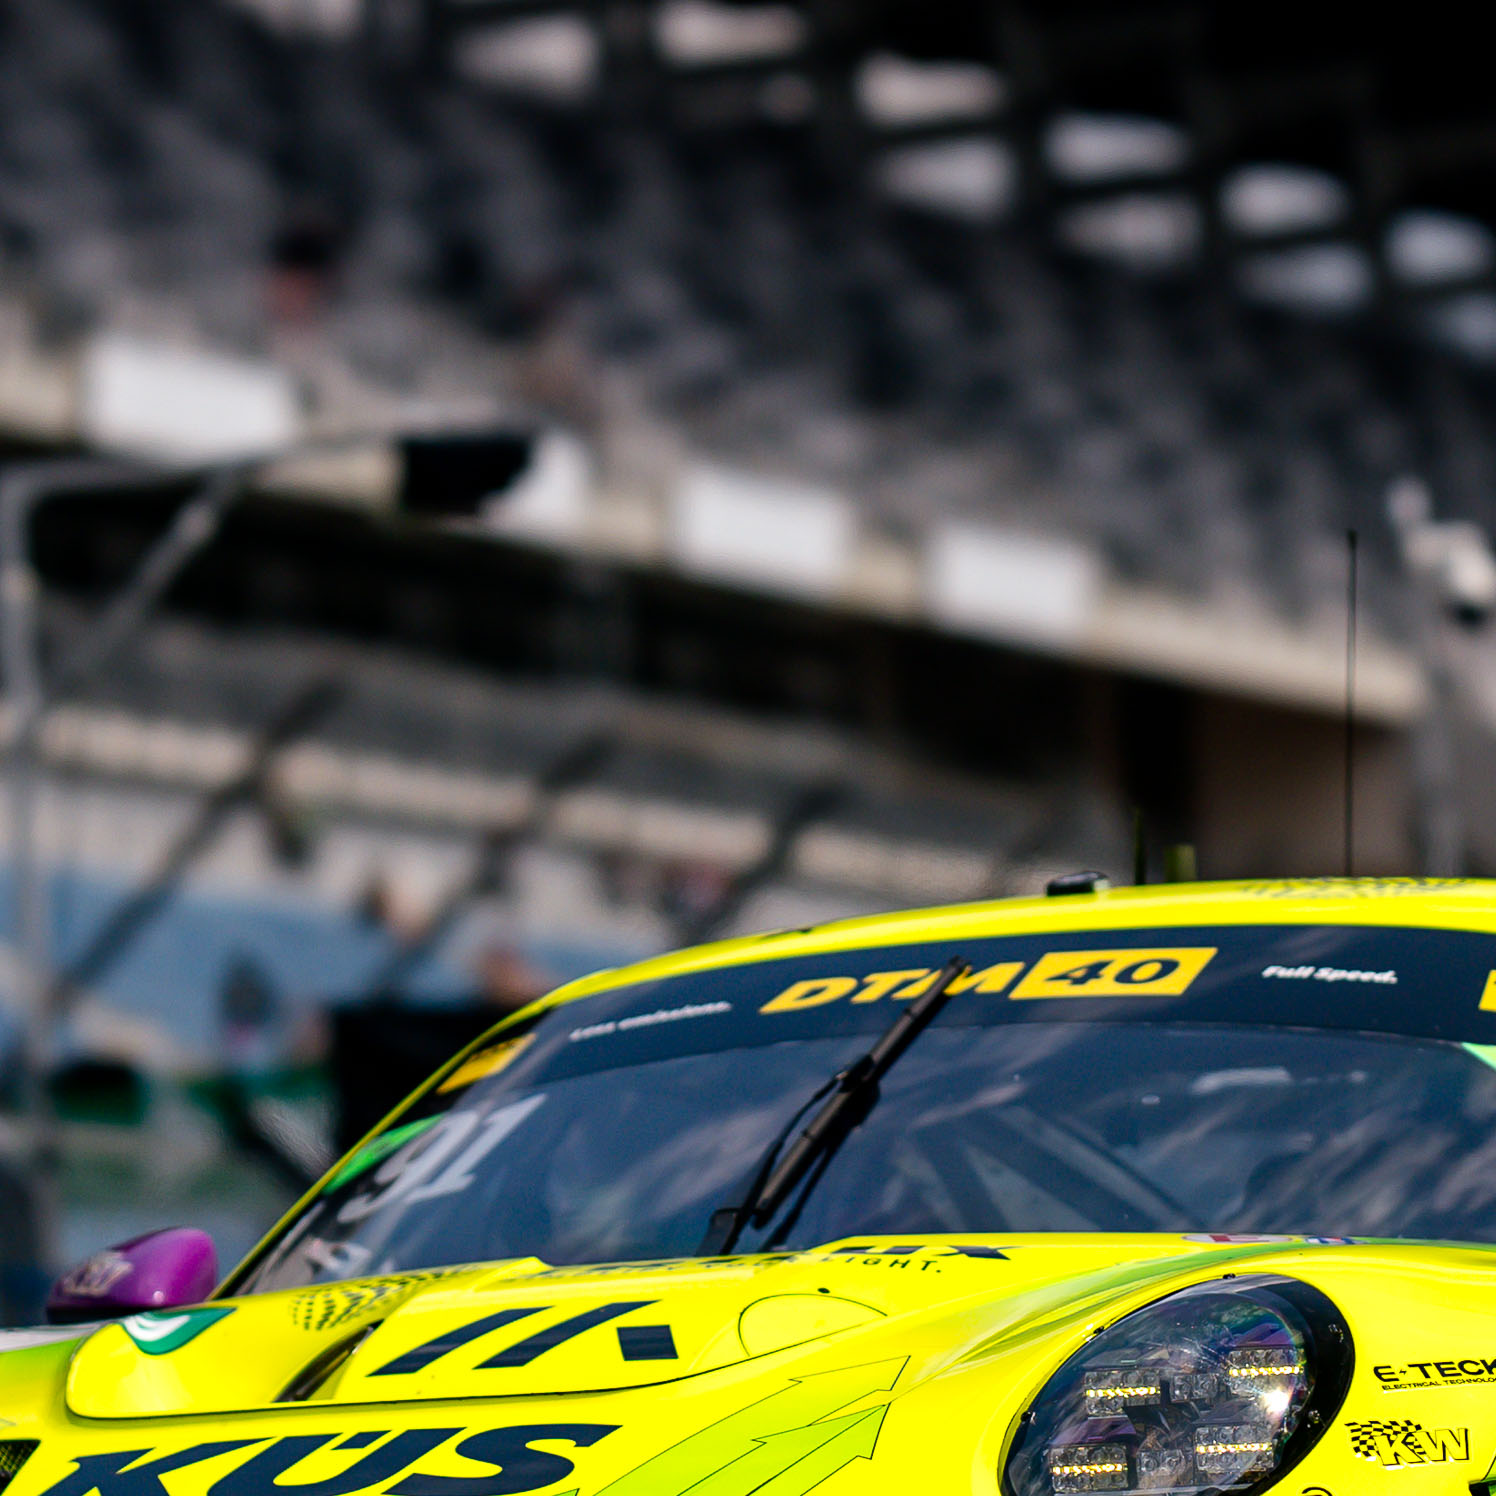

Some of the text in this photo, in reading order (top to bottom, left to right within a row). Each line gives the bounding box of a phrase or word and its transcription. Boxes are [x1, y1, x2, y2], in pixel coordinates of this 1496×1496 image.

[759, 958, 1181, 1014] DTM 40
[1262, 965, 1398, 984] Full Speed.
[1382, 1380, 1441, 1391] ELECTRICAL
[1374, 1428, 1469, 1466] KW
